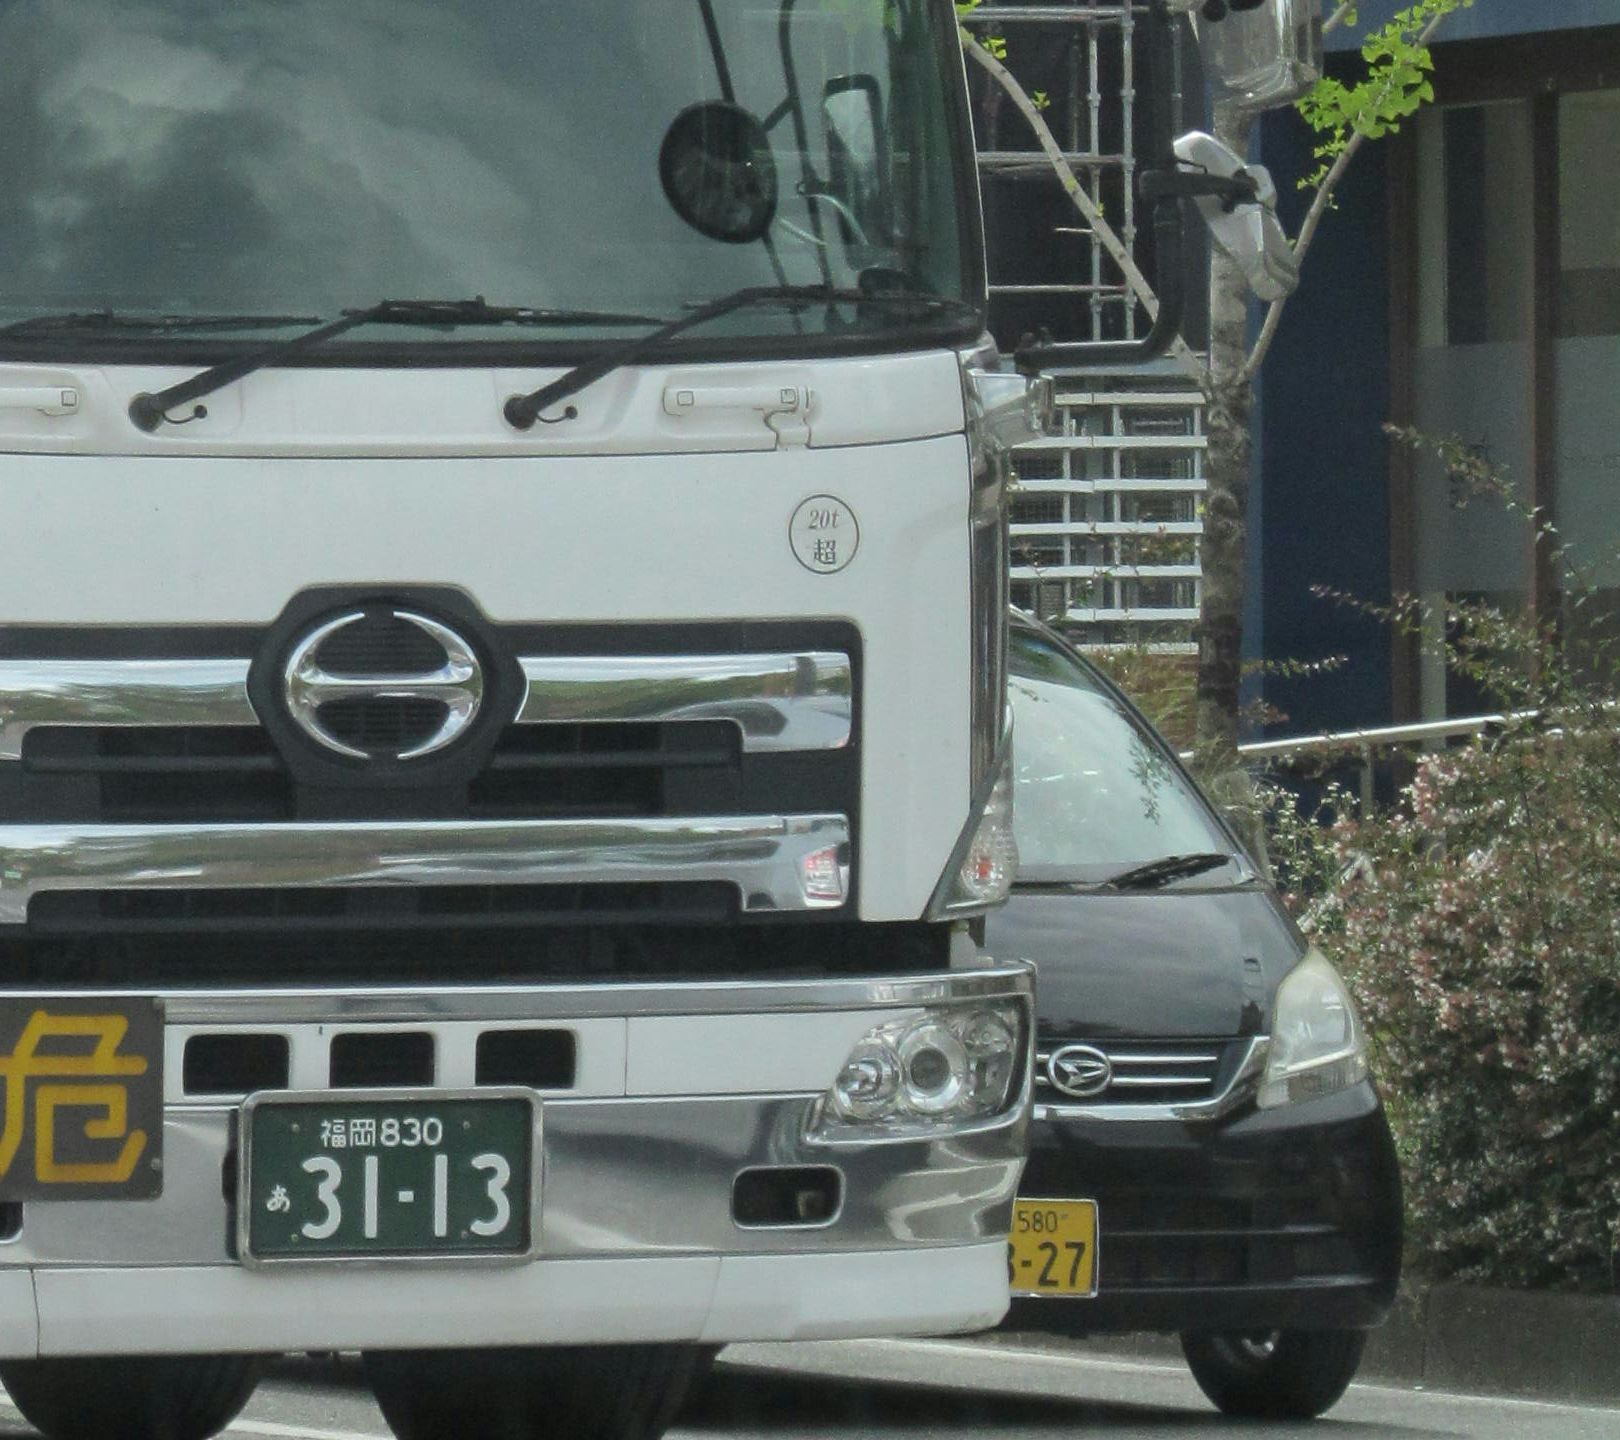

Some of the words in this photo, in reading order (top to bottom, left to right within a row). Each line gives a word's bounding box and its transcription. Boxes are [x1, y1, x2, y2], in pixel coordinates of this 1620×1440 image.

[809, 508, 839, 529] 20t
[814, 538, 836, 564] 超
[301, 1153, 511, 1240] 31-13
